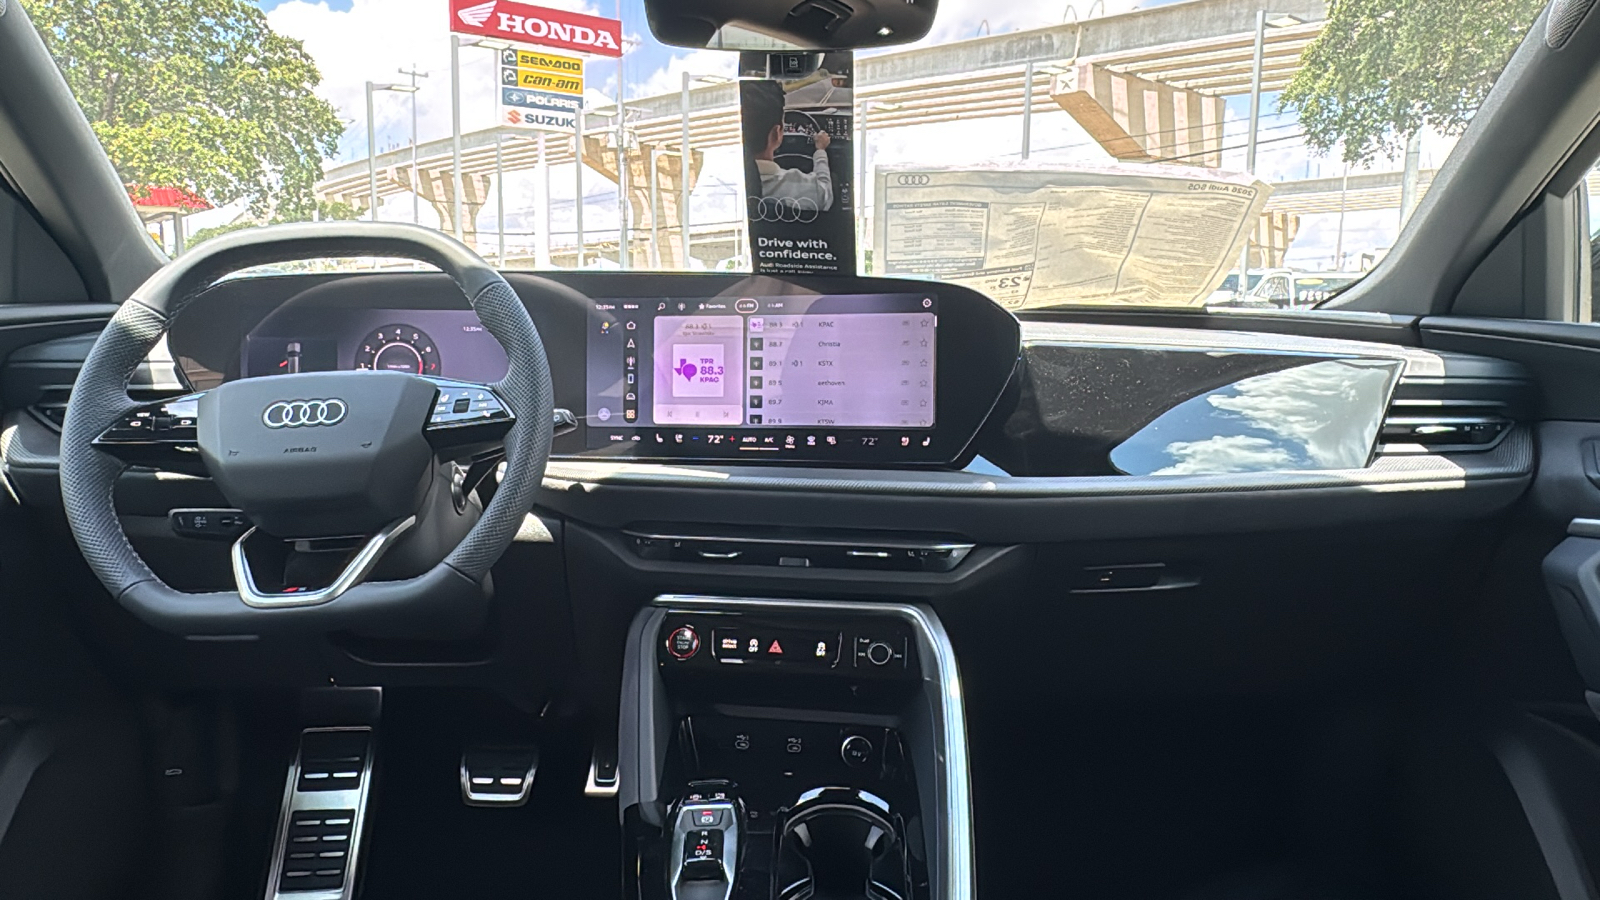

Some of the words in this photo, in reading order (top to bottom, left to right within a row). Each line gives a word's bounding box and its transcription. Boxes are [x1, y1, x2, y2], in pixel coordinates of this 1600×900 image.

[497, 12, 619, 50] HONDA
[522, 74, 580, 91] can-am
[526, 94, 579, 109] POLARIS
[524, 113, 576, 129] SUZUK
[758, 237, 793, 247] Drive
[797, 239, 828, 249] with
[759, 249, 837, 260] confidence.
[377, 332, 384, 340] 3
[364, 345, 371, 353] 2
[700, 366, 724, 375] 88.3
[283, 446, 317, 454] AIRBAG
